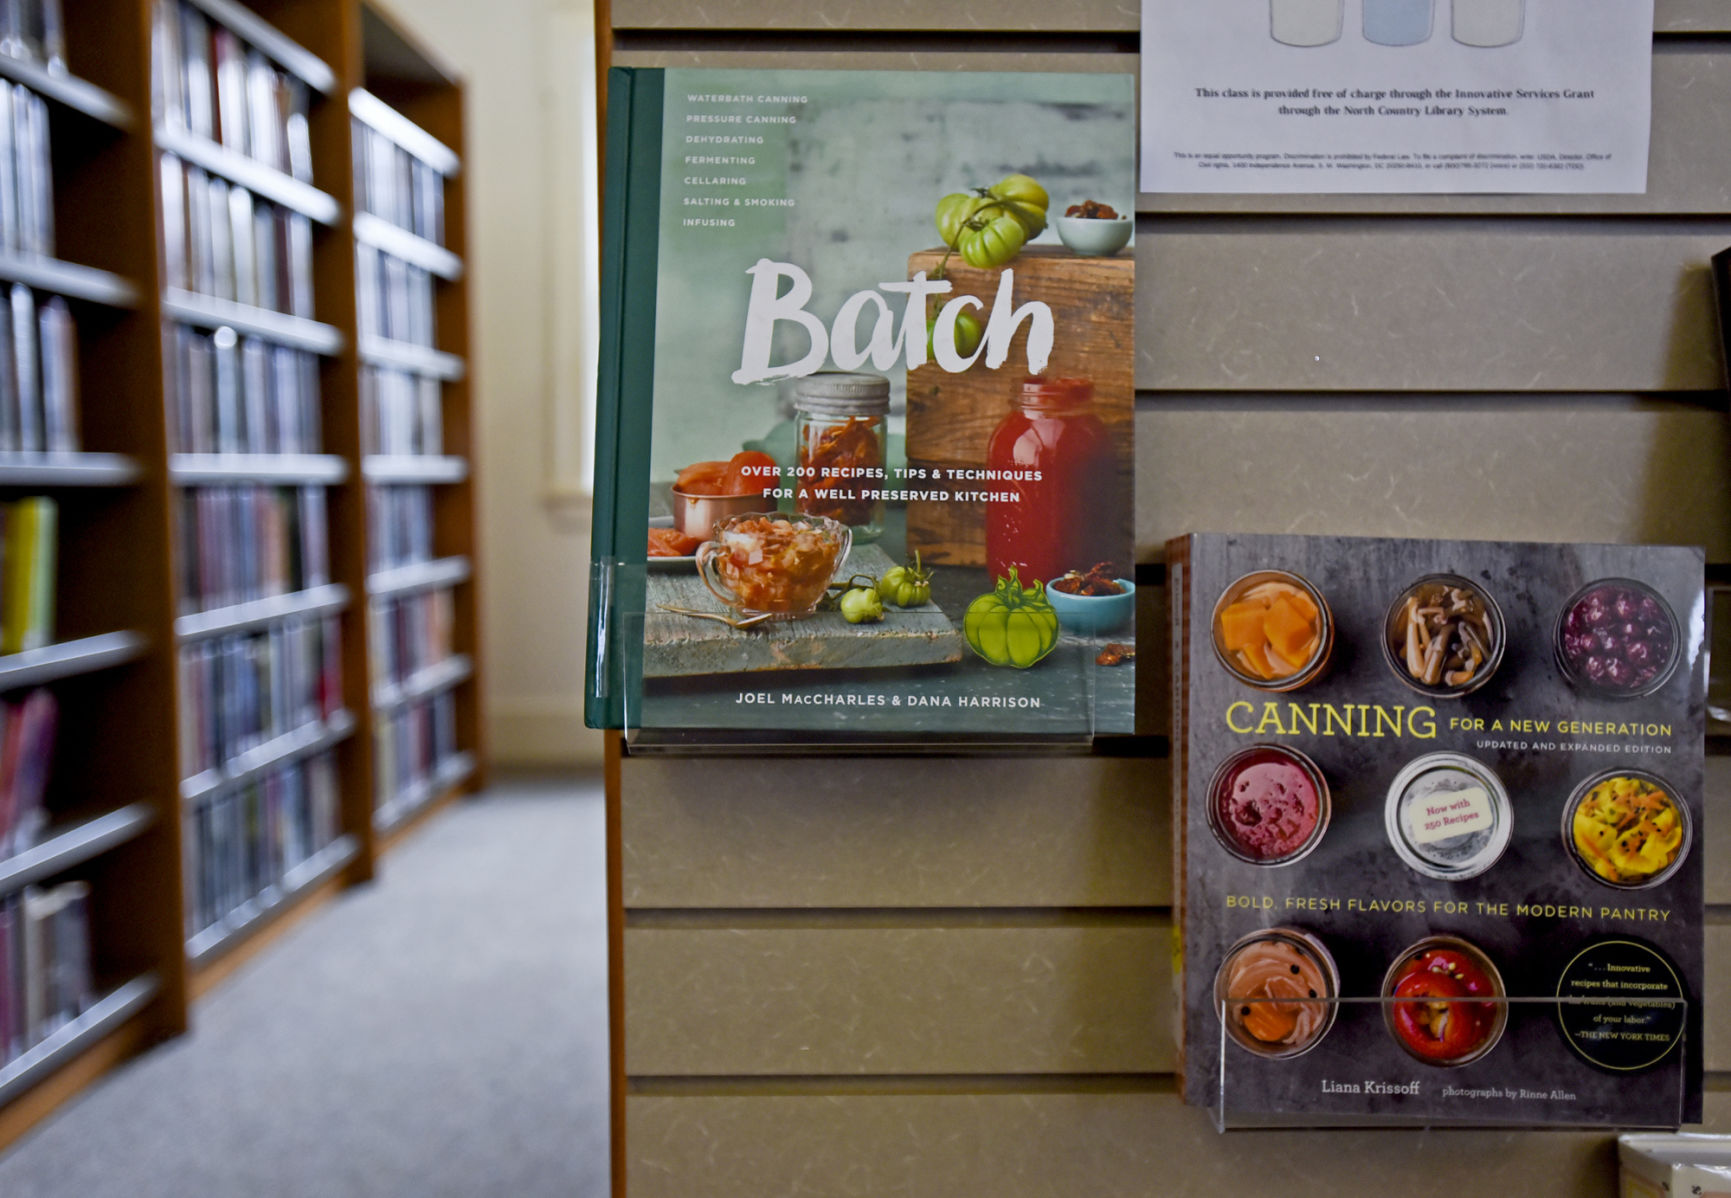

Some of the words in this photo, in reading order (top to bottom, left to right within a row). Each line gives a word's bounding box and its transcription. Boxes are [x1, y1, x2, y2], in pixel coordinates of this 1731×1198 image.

[687, 94, 754, 103] WATERBATH
[757, 95, 808, 104] CANNING
[1195, 88, 1219, 98] This
[1222, 88, 1249, 98] class
[1252, 88, 1261, 98] is
[1263, 89, 1309, 100] provided
[1312, 89, 1334, 99] free
[1336, 89, 1347, 99] of
[1350, 89, 1386, 100] charge
[1389, 89, 1432, 100] through
[1435, 89, 1452, 99] the
[1455, 89, 1513, 99] Innovative
[1516, 89, 1560, 99] Services
[1563, 89, 1595, 99] Grant
[1278, 105, 1321, 117] through
[1324, 106, 1342, 115] the
[1344, 106, 1375, 115] North
[1378, 106, 1421, 117] Country
[1424, 106, 1464, 117] Library
[686, 115, 742, 123] PRESSURE
[746, 115, 797, 124] CANNING
[686, 136, 764, 144] DEHYDRATING
[685, 156, 756, 165] FERMENTING
[684, 177, 746, 185] CELLARING
[683, 198, 730, 206] SALTING
[734, 198, 741, 206] &
[744, 198, 795, 207] SMOKING
[683, 218, 736, 227] INFUSING
[731, 258, 1054, 385] Batch
[741, 466, 782, 477] OVER
[787, 466, 816, 478] 200
[820, 466, 889, 480] RECIPES,
[894, 468, 927, 479] TIPS
[932, 469, 941, 480] &
[946, 469, 1042, 481] TECHNIQUES
[763, 488, 793, 499] FOR
[799, 488, 809, 499] A
[814, 489, 856, 500] WELL
[861, 490, 949, 502] PRESERVED
[954, 491, 1020, 503] KITCHEN
[735, 693, 775, 704] JOEL
[891, 695, 901, 706] &
[907, 696, 952, 707] DANA
[958, 697, 1041, 708] HARRISON
[1226, 700, 1437, 739] CANNING
[1449, 718, 1485, 731] FOR
[1491, 719, 1503, 732] A
[1510, 719, 1551, 733] NEW
[1557, 720, 1672, 737] GENERATION
[1476, 740, 1527, 751] UPDATED
[1532, 741, 1556, 752] AND
[1559, 742, 1621, 753] EXPANDED
[1624, 744, 1672, 754] EDITION
[1426, 805, 1448, 816] Now
[1449, 798, 1471, 810] with
[1443, 812, 1479, 826] Recipes
[1286, 897, 1341, 911] FRESH
[1348, 899, 1426, 913] FLAVORS
[1433, 901, 1469, 915] FOR
[1475, 902, 1509, 916] THE
[1517, 903, 1593, 918] MODERN
[1601, 907, 1671, 921] PANTRY
[1607, 963, 1651, 973] Innovative
[1571, 980, 1600, 989] recipes
[1602, 979, 1619, 988] that
[1621, 981, 1668, 991] incorporate
[1593, 1014, 1602, 1022] of
[1603, 1016, 1622, 1024] your
[1599, 1031, 1619, 1039] NEW
[1620, 1031, 1643, 1040] YORK
[1645, 1033, 1670, 1041] TIMES
[1321, 1079, 1361, 1093] Liana
[1364, 1080, 1421, 1095] Krissoff
[1442, 1086, 1503, 1099] photographs
[1505, 1088, 1517, 1100] by
[1519, 1089, 1548, 1100] Rinne
[1550, 1090, 1576, 1101] Allen
